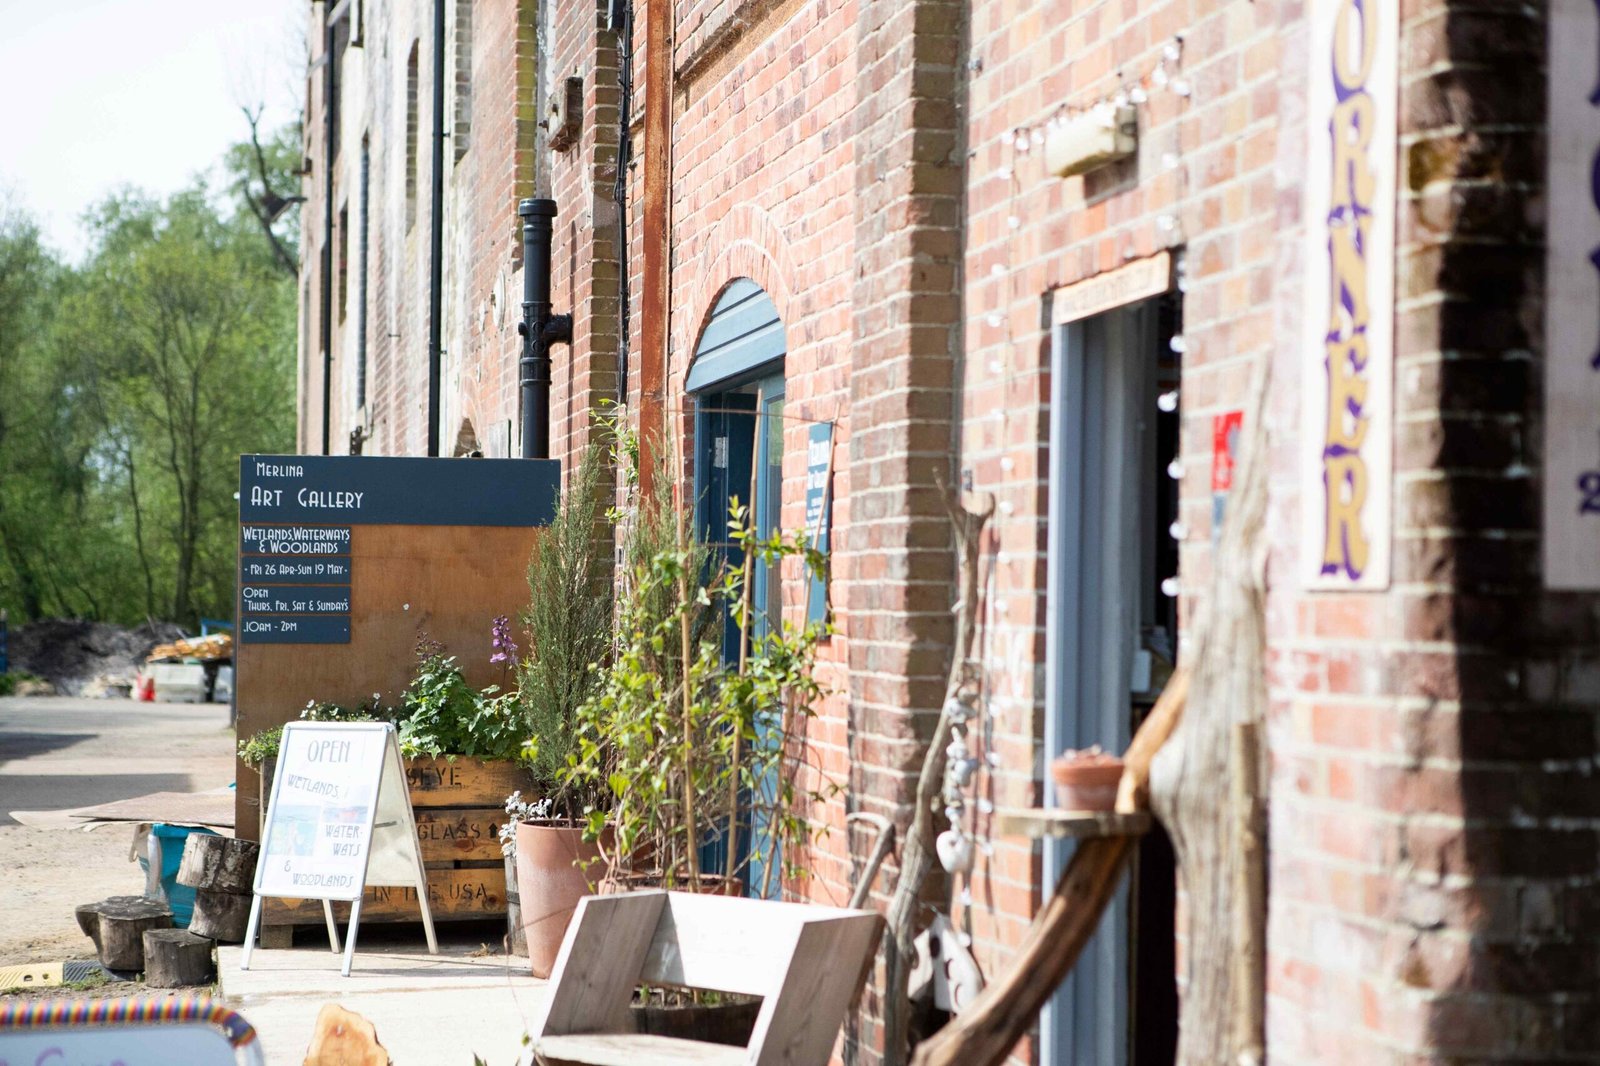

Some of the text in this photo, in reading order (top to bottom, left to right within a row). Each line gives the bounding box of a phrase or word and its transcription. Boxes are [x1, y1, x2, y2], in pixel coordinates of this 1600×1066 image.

[256, 462, 304, 477] MERLINA
[251, 485, 364, 509] ART GALLERY
[259, 540, 339, 554] & WOODLANDS
[250, 564, 262, 575] FRI
[264, 564, 277, 575] 26
[315, 564, 325, 575] 19
[327, 564, 344, 575] MAY
[242, 587, 269, 599] OPEN
[292, 600, 306, 611] SAT
[308, 600, 314, 611] &
[316, 600, 349, 611] SUNDAYS
[307, 740, 351, 763] OPEN
[417, 823, 480, 840] GLASS
[332, 843, 361, 857] WAYS
[292, 873, 354, 888] WOODLANDS
[449, 883, 488, 901] USA
